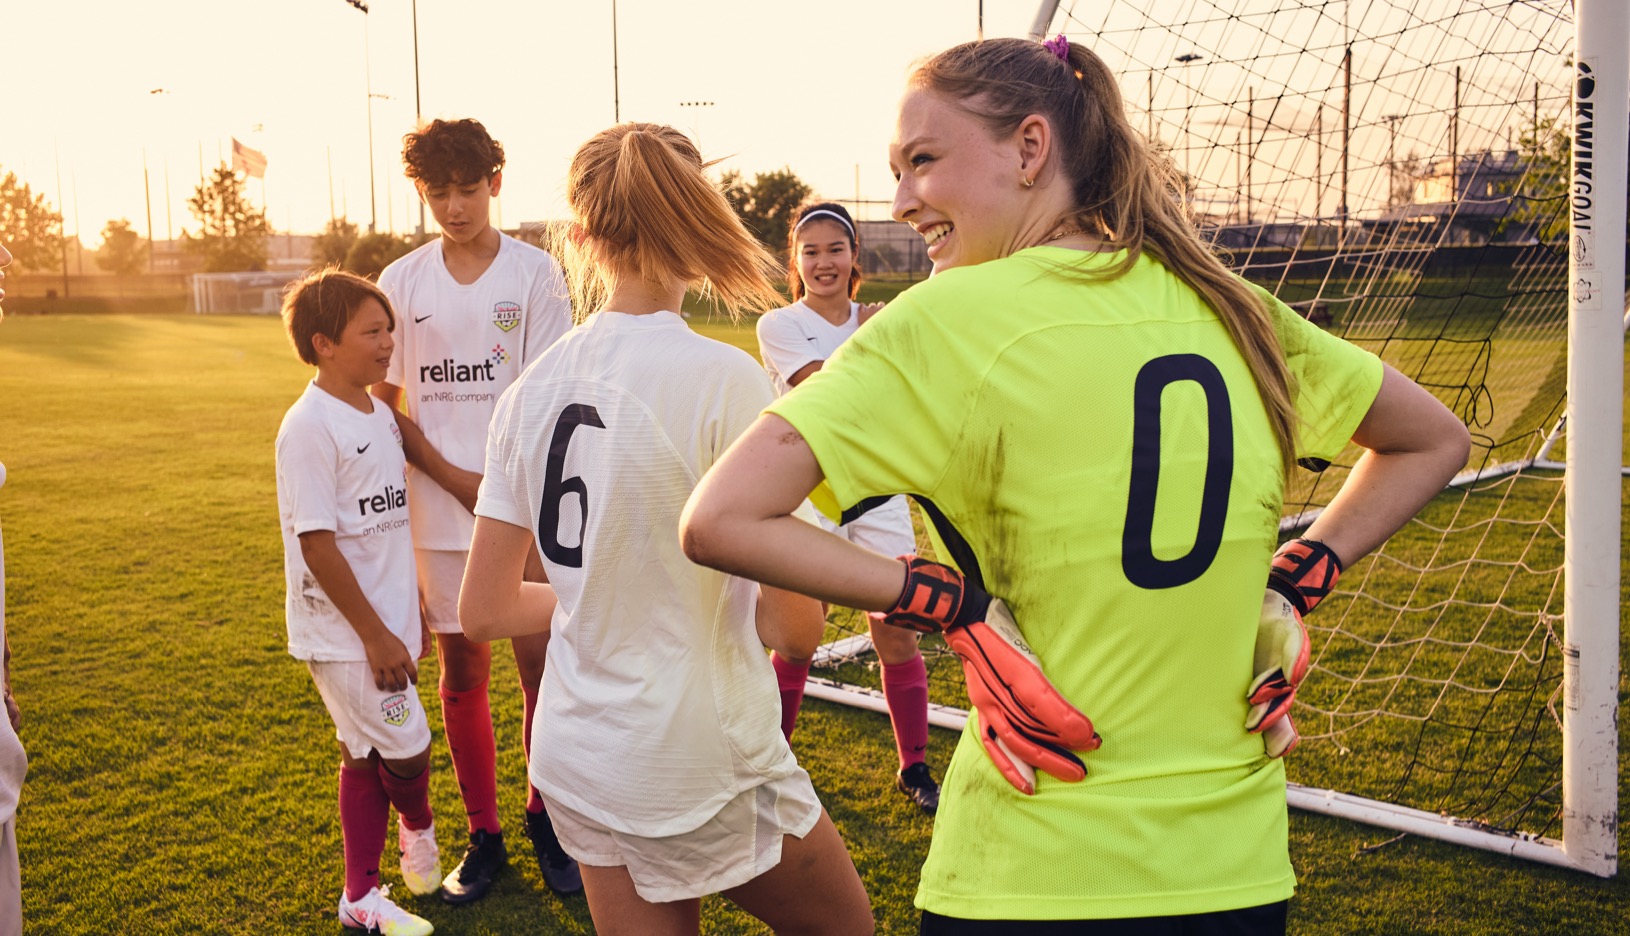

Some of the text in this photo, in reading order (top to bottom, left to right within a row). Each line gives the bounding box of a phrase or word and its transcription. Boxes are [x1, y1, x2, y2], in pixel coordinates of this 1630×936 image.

[420, 359, 495, 383] reliant
[421, 394, 433, 403] an
[434, 392, 453, 402] NRG
[1121, 353, 1234, 590] 0
[538, 403, 607, 568] 6
[363, 527, 376, 536] an
